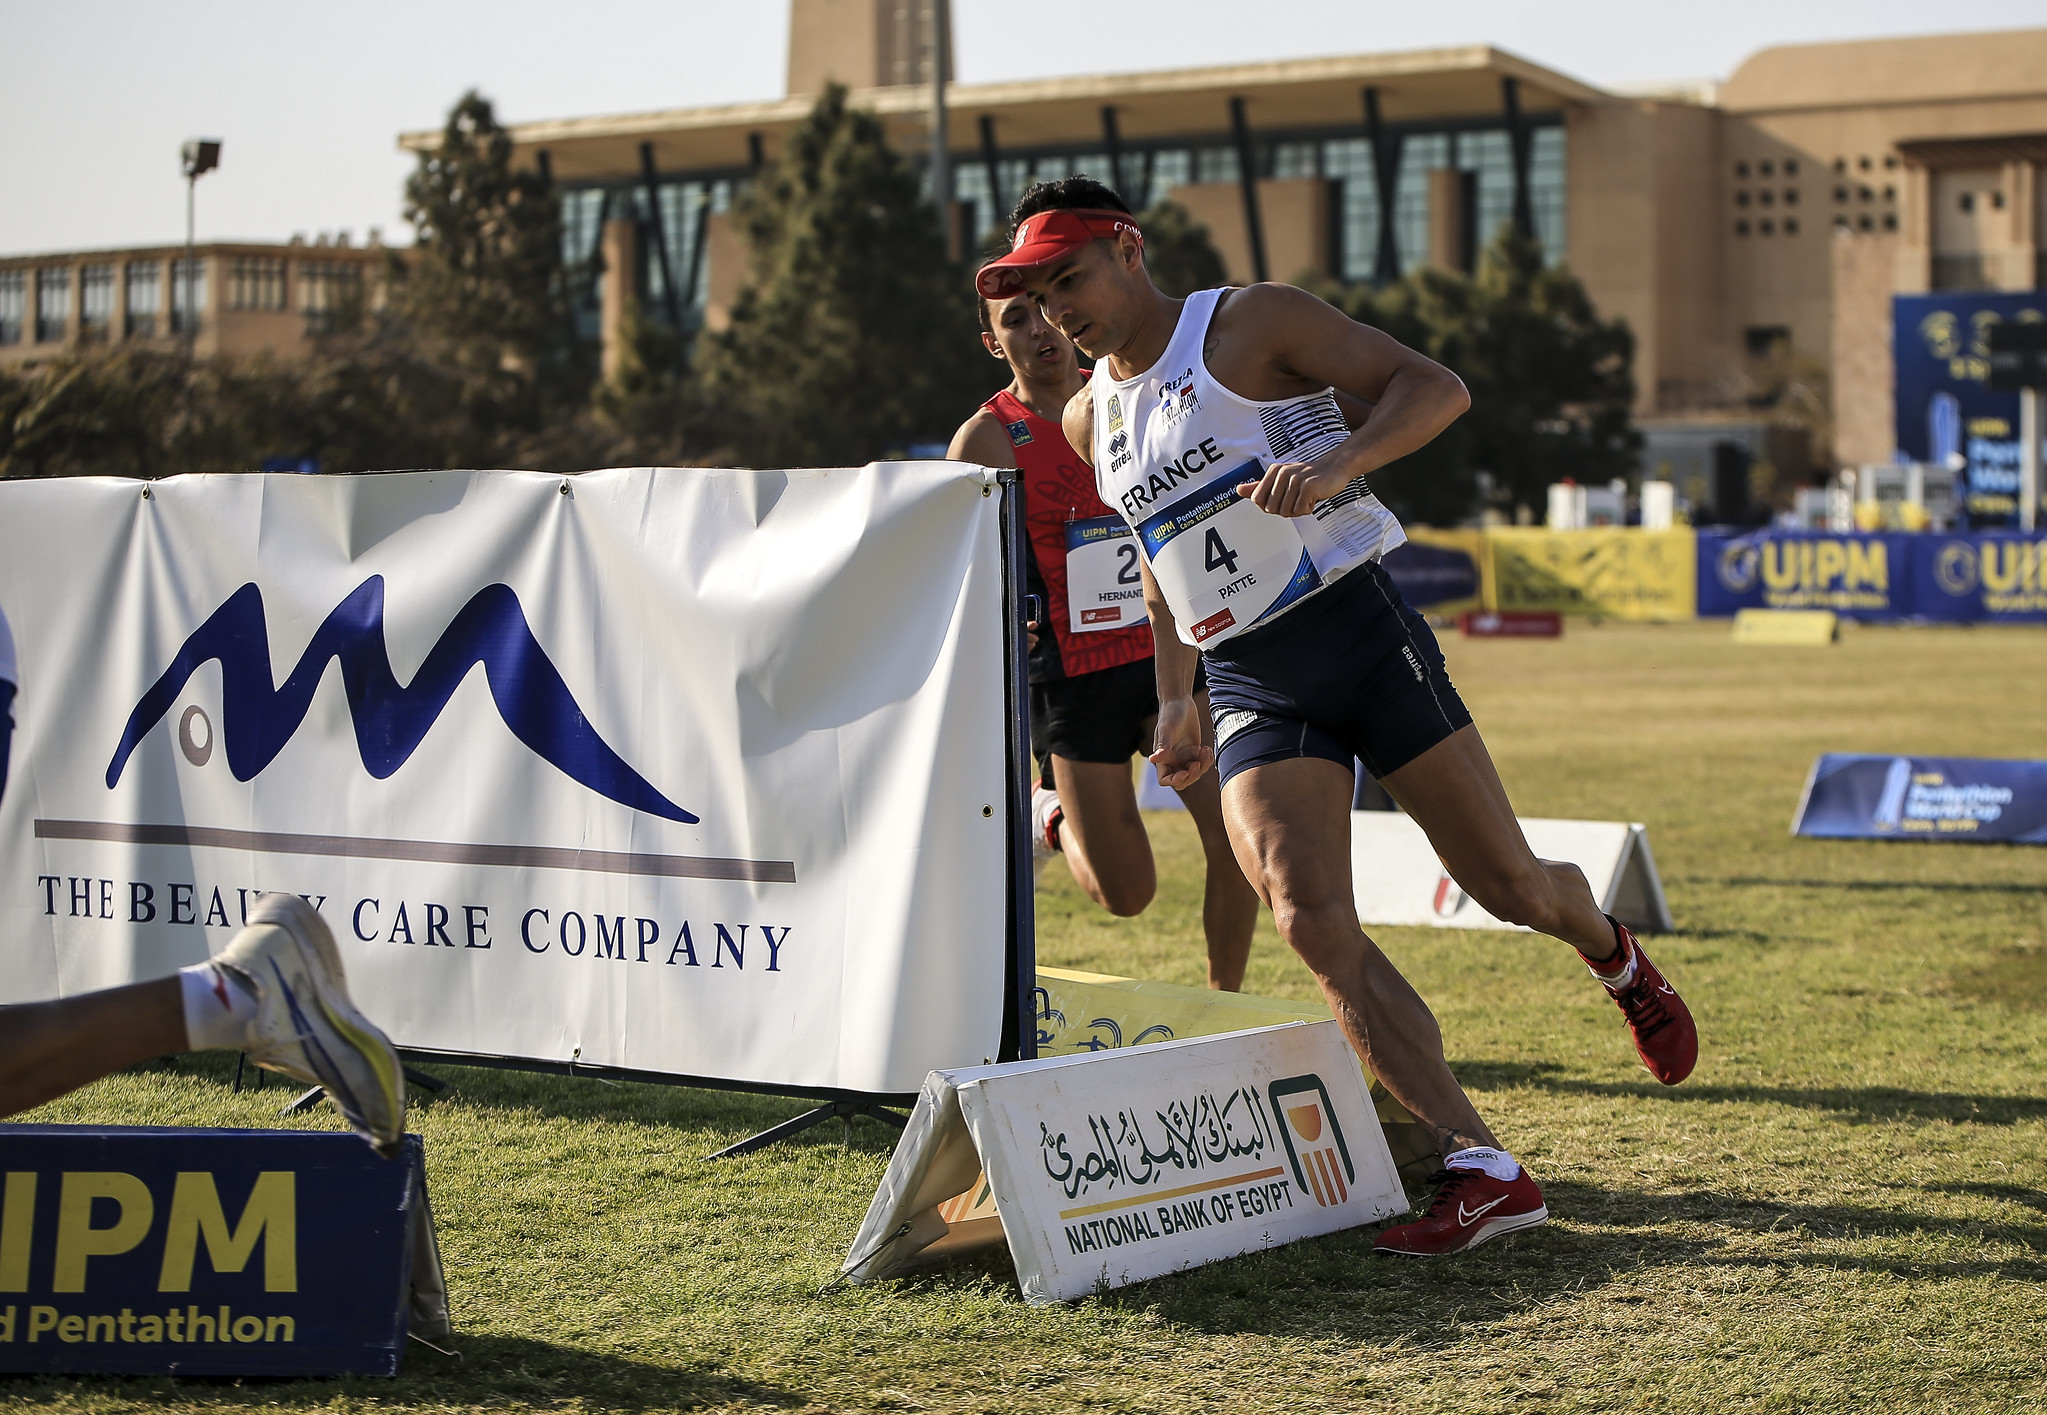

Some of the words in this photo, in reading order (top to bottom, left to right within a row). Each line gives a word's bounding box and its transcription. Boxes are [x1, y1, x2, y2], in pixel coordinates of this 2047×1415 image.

[1111, 450, 1132, 473] errea
[1120, 436, 1225, 517] FRANCE
[1176, 499, 1215, 524] Pentathlon
[1196, 508, 1215, 522] EGYPT
[1215, 499, 1231, 512] 2022
[1083, 527, 1107, 538] UIPM
[1152, 520, 1176, 540] UIPM
[1117, 543, 1141, 585] 2
[1204, 526, 1239, 575] 4
[1763, 540, 1888, 590] UIPM
[1981, 541, 2047, 592] UI
[1218, 573, 1257, 600] PATTE
[1402, 645, 1422, 672] errea
[38, 876, 114, 919] THE
[352, 898, 493, 949] CARE
[520, 908, 792, 972] COMPANY
[1064, 1211, 1160, 1255] NATIONAL
[1157, 1199, 1212, 1235] BANK
[1212, 1193, 1238, 1223] OF
[1237, 1180, 1294, 1218] EGYPT
[28, 1305, 296, 1343] Pentathlon
